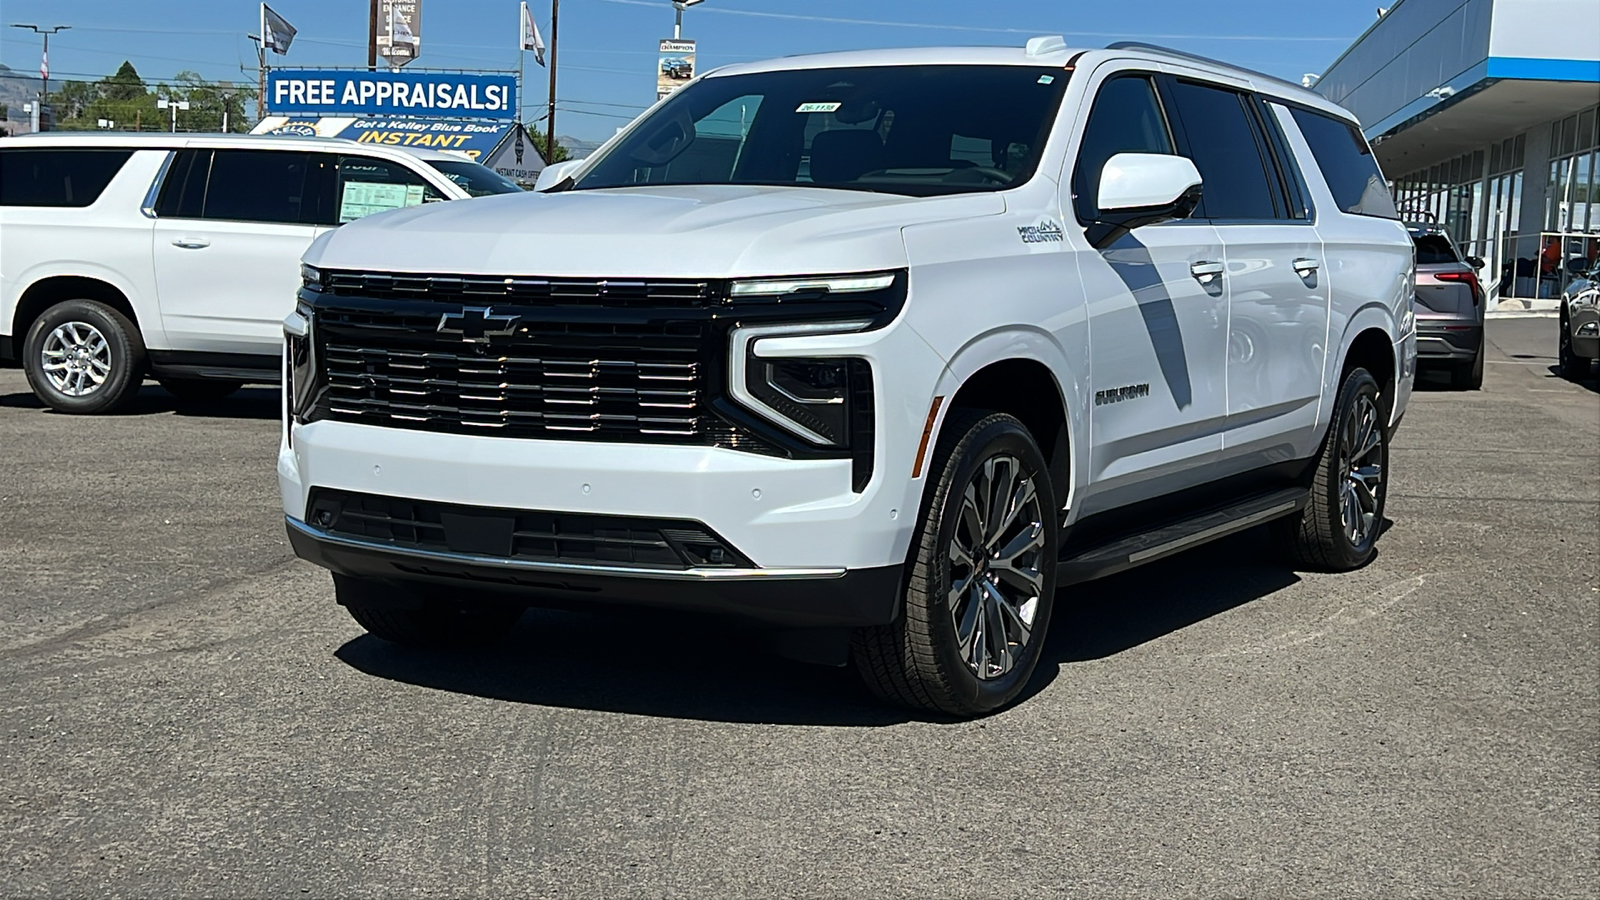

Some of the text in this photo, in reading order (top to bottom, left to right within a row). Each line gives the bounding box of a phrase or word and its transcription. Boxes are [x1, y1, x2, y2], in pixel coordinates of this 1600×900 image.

[275, 80, 508, 110] FREE APPRAISALS!
[272, 126, 315, 136] KELLE
[354, 120, 375, 129] Get
[388, 121, 430, 132] Kelley
[430, 123, 462, 132] Blue
[357, 131, 473, 148] INSTANT
[515, 169, 527, 178] CASH
[528, 170, 541, 179] OFFE
[1022, 234, 1063, 243] COUNTRY
[1095, 383, 1150, 401] SUBURBAN
